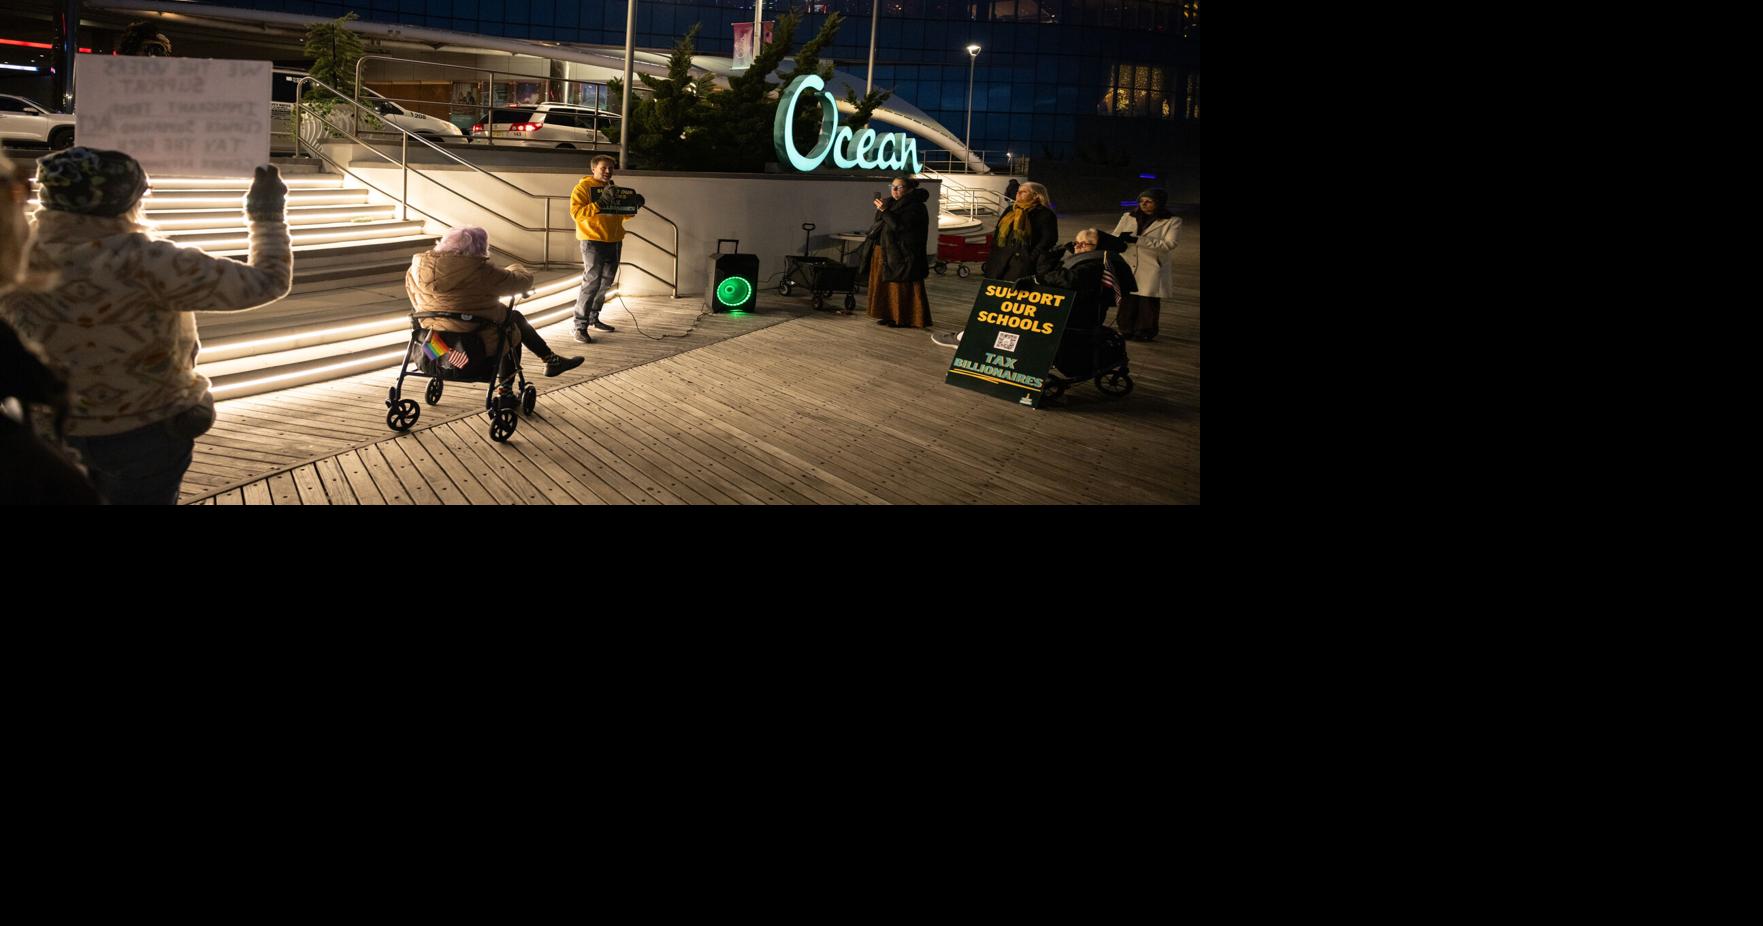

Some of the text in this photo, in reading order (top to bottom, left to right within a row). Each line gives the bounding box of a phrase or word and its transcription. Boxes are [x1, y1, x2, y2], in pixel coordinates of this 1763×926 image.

[774, 74, 923, 174] Ocean
[985, 285, 1065, 307] SUPPORT
[1000, 301, 1037, 317] OUR
[977, 311, 1054, 335] SCHOOLS
[985, 352, 1018, 370] TAX
[953, 358, 1044, 388] BILLIONAIRES
